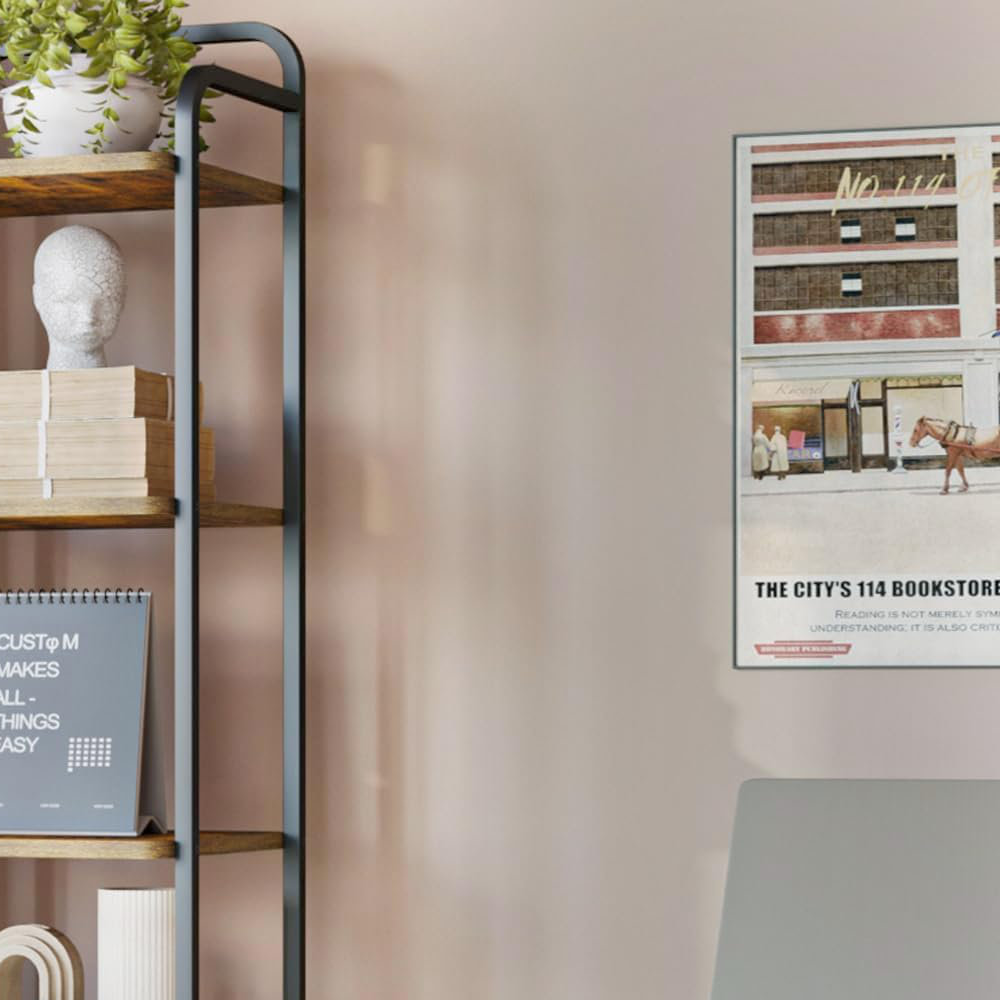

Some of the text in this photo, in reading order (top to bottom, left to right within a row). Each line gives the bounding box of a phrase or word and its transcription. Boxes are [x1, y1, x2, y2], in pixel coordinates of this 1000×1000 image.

[755, 579, 1000, 598] THE CITY'S 114 BOOKSTORE
[835, 609, 1000, 619] READING IS NOT MERELY SYM
[910, 623, 921, 633] IT
[923, 623, 935, 633] IS
[936, 623, 968, 633] ALSO
